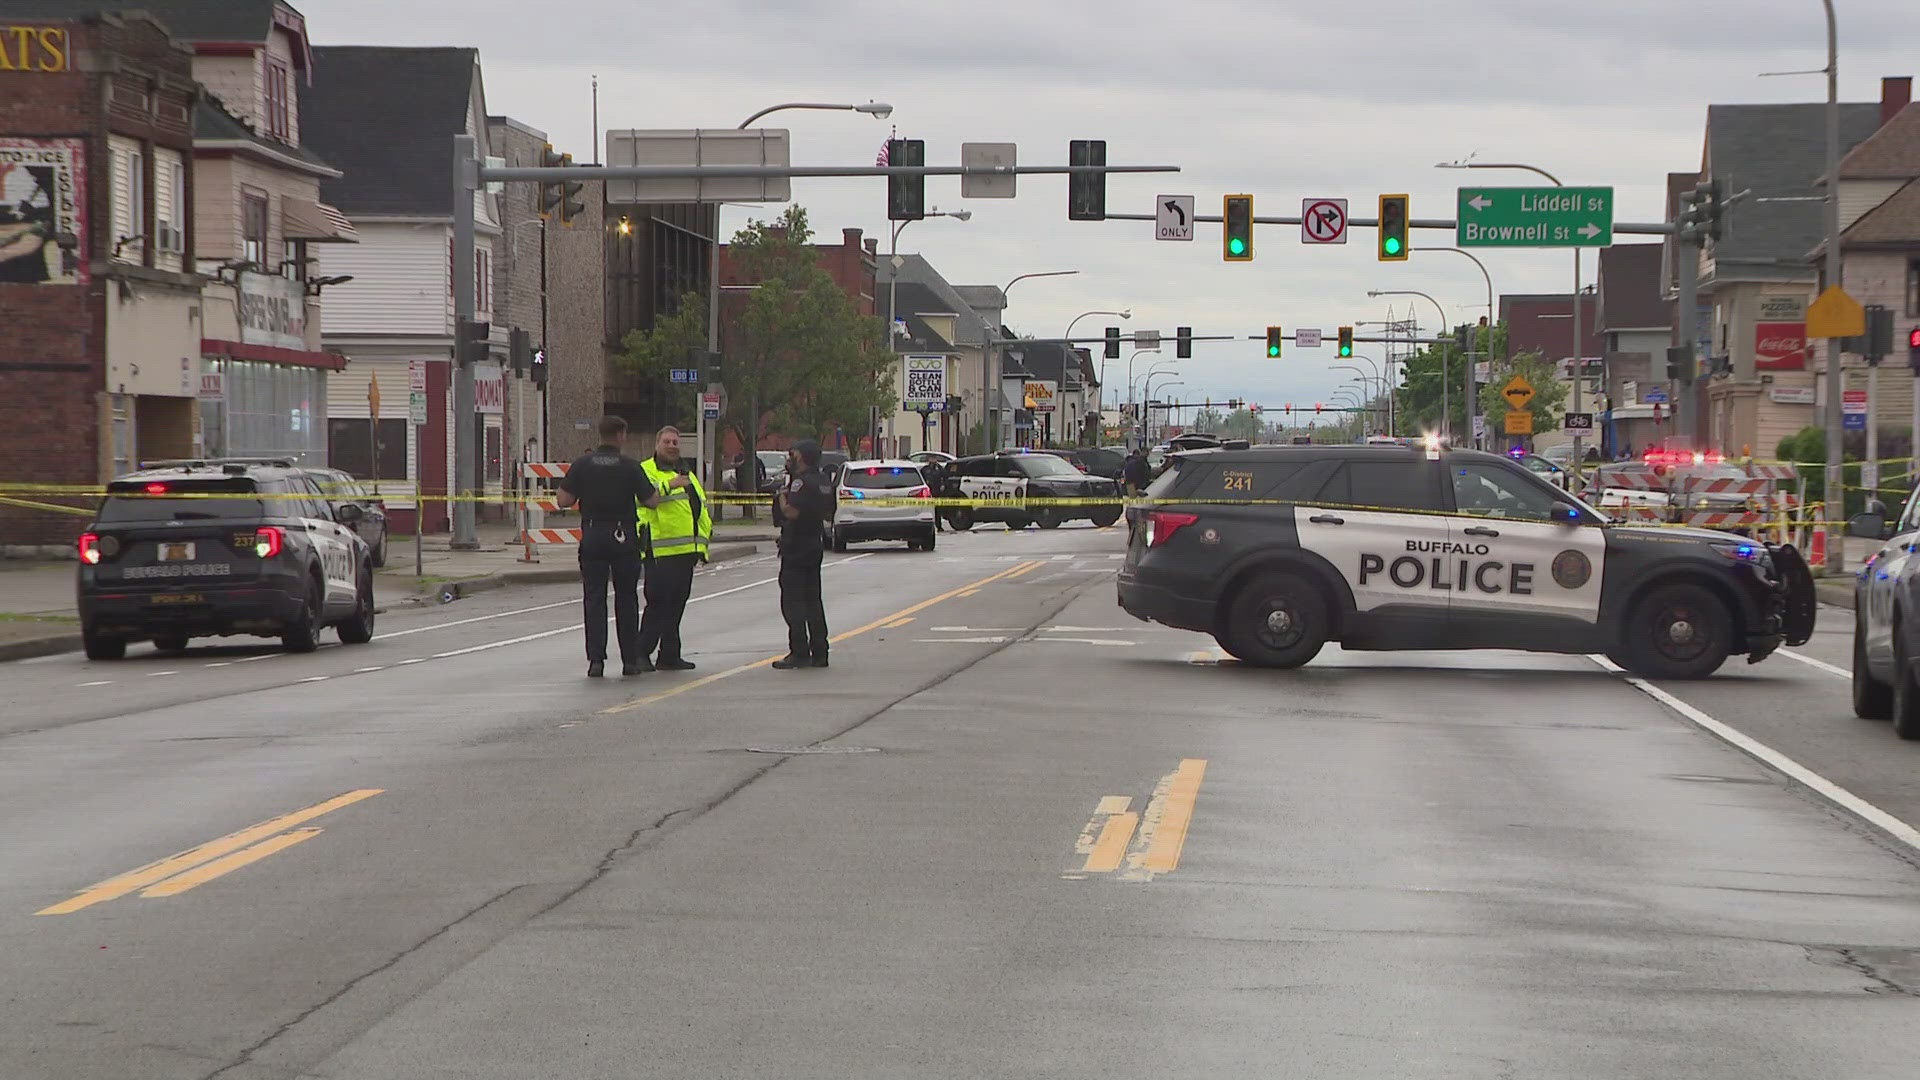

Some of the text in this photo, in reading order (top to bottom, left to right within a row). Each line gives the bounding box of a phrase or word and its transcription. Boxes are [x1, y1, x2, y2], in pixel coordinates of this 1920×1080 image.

[37, 151, 64, 163] ICE
[1520, 194, 1604, 212] Liddell St
[1161, 227, 1188, 237] ONLY
[1466, 222, 1569, 241] Brownell St
[671, 371, 698, 381] LIDDLL
[1222, 470, 1253, 478] C-District
[1223, 476, 1253, 491] 241
[972, 490, 1011, 500] POLICE
[233, 538, 255, 549] 237
[1405, 540, 1490, 557] BUFFALO
[124, 564, 231, 580] BUFFALO POLICE
[1359, 553, 1535, 597] POLICE
